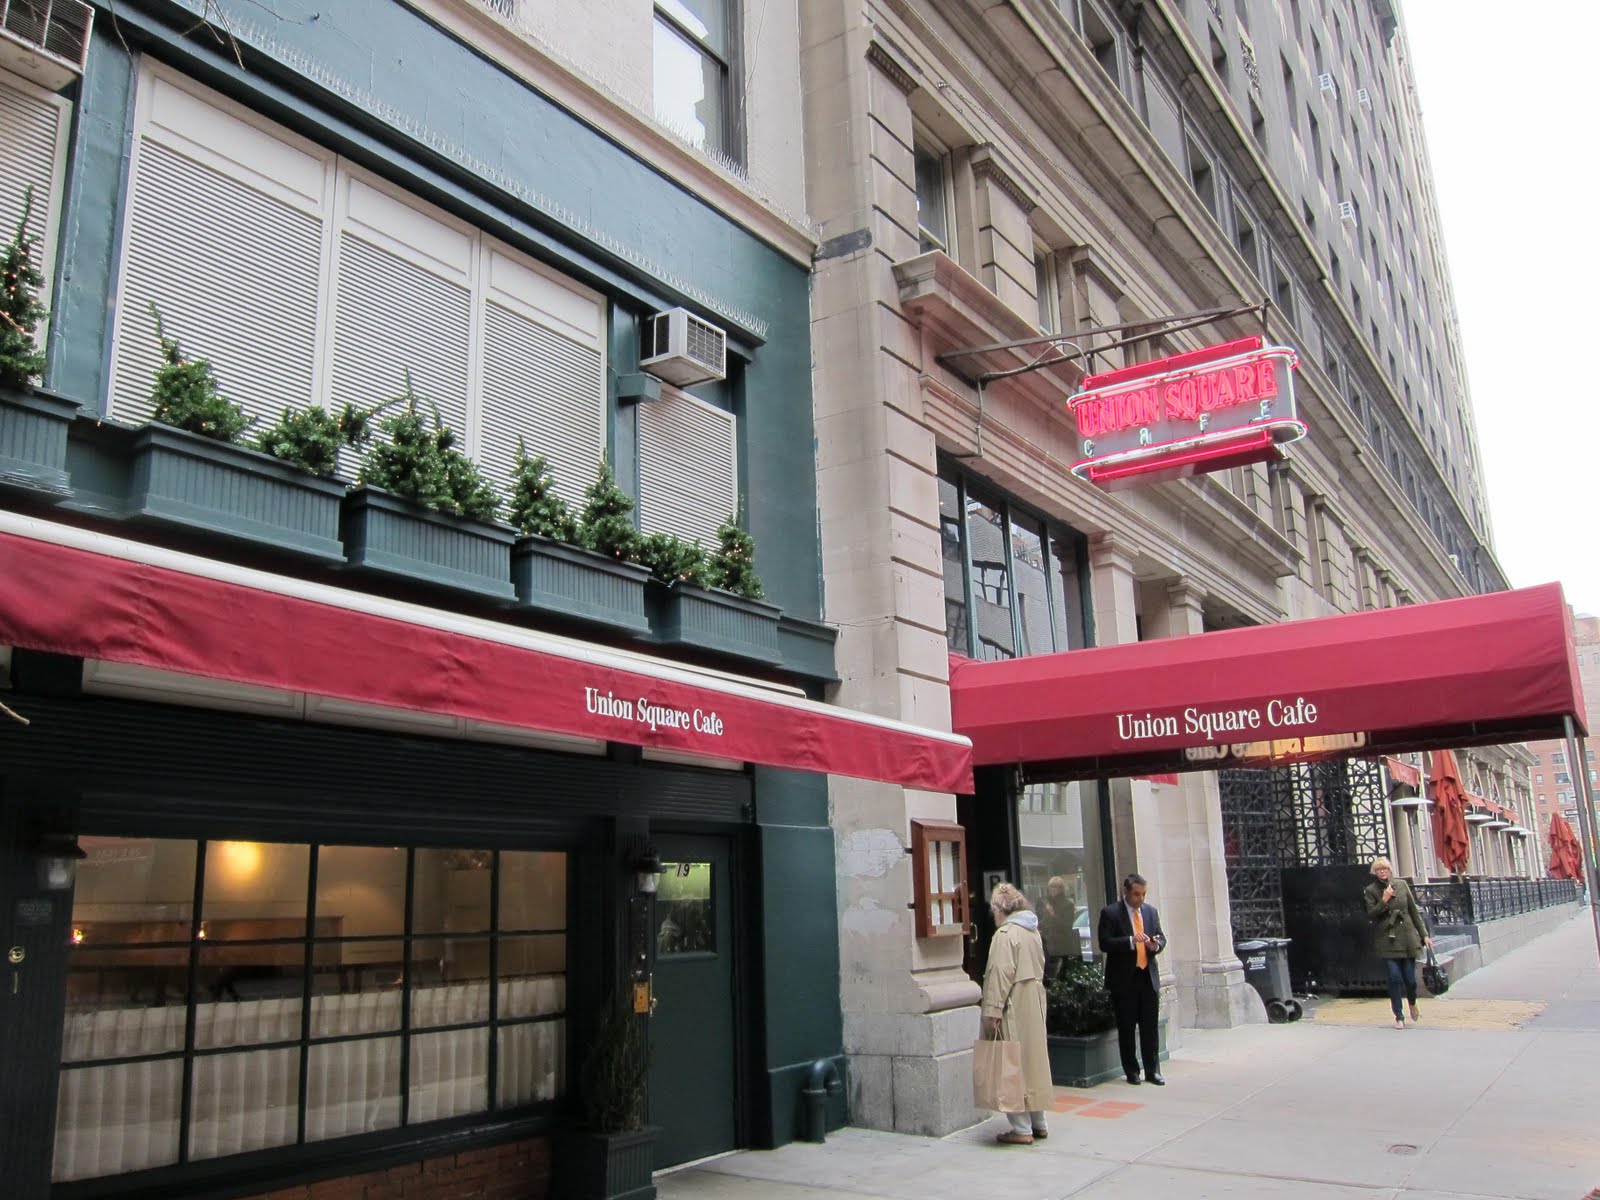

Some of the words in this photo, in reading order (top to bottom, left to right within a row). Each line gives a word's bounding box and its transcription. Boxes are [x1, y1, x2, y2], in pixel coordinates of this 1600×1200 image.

[1076, 387, 1160, 437] UNION
[1164, 359, 1277, 420] SQUARE
[585, 686, 633, 720] Union
[636, 697, 690, 731] Square
[693, 708, 724, 736] Cafe
[1116, 713, 1179, 740] Union
[1184, 708, 1260, 740] Square
[1267, 697, 1318, 728] Cafe
